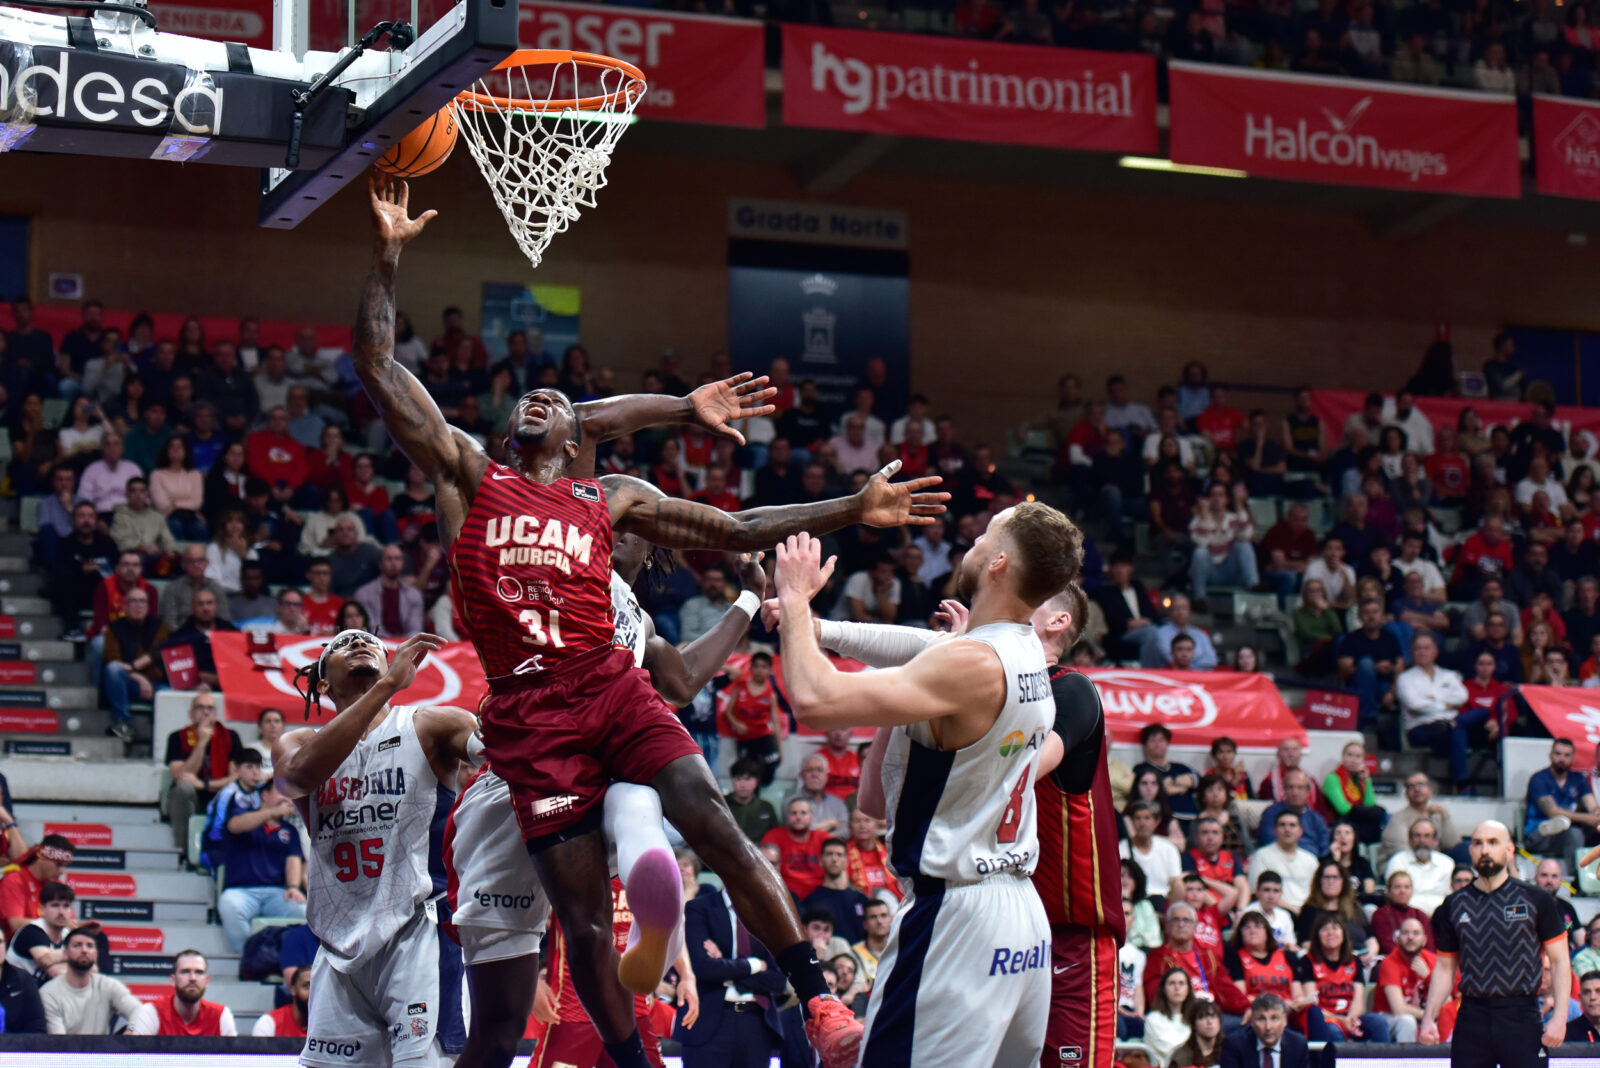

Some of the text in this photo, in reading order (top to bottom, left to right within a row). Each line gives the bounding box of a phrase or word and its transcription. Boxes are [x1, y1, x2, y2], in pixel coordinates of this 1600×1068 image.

[874, 59, 1133, 117] patrimonial
[735, 206, 899, 240] Grada Norte
[485, 515, 593, 566] UCAM
[499, 547, 571, 576] MURCIA
[518, 609, 566, 648] 31
[1100, 685, 1195, 717] uver
[996, 763, 1031, 844] 8
[334, 837, 385, 882] 95
